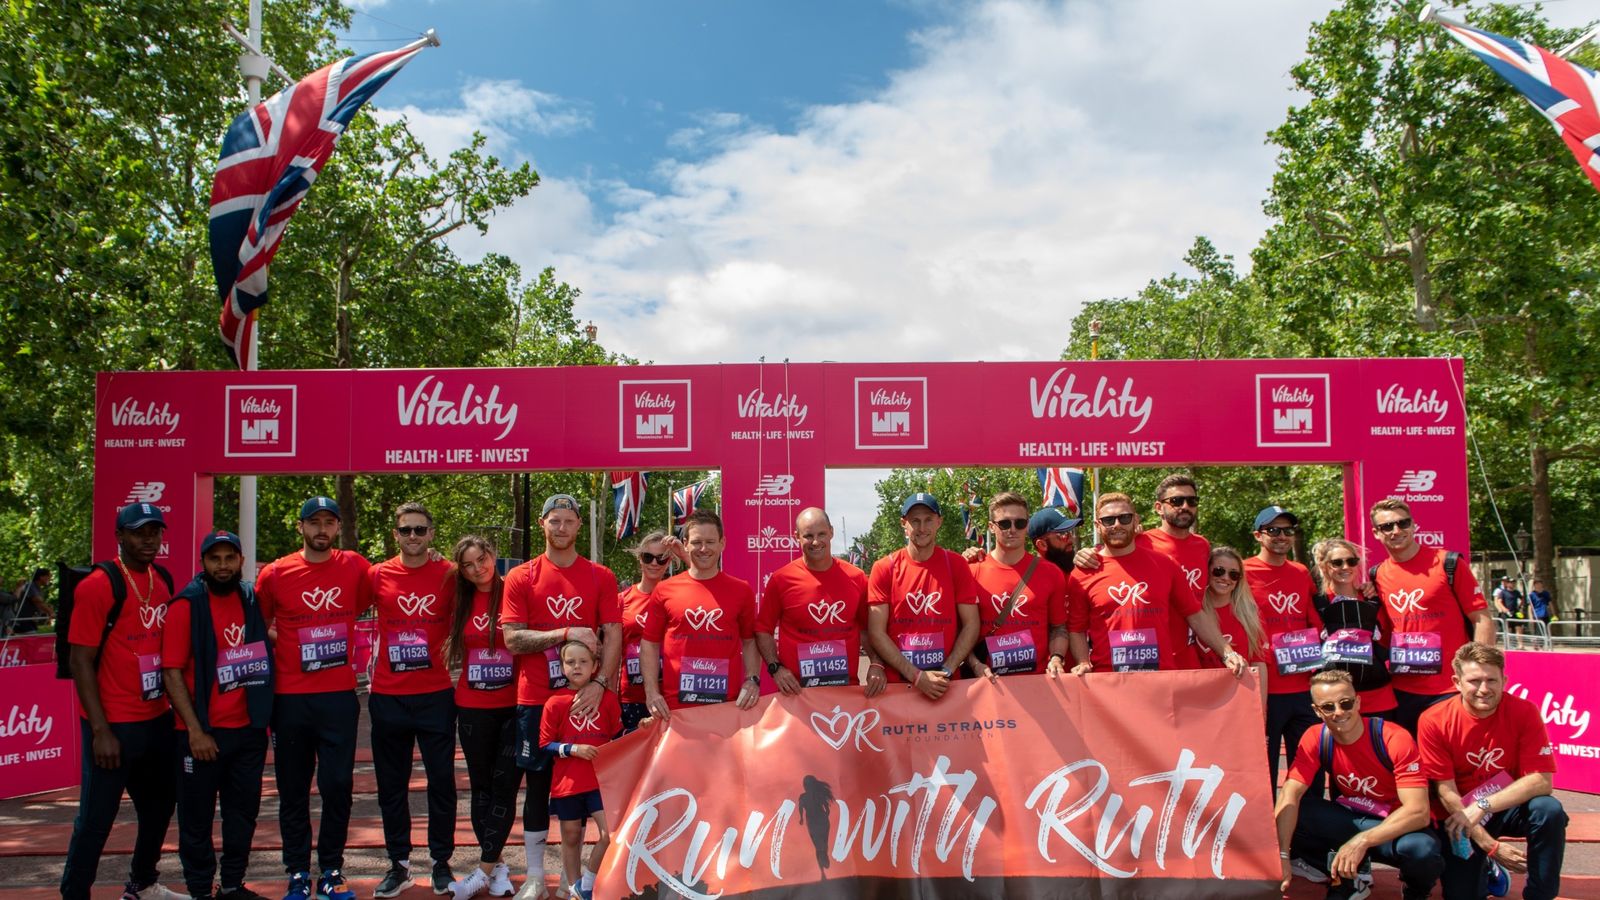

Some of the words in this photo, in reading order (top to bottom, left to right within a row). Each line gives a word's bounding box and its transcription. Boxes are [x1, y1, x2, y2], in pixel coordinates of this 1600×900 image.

[635, 391, 675, 412] Vitality
[871, 388, 911, 410] Vitality
[1030, 368, 1152, 433] Vitality
[1272, 385, 1314, 407] Vitality
[1377, 384, 1448, 422] Vitality
[241, 396, 281, 418] Vitality
[398, 375, 518, 441] Vitality
[738, 389, 807, 426] Vitality
[112, 397, 180, 434] Vitality
[732, 431, 761, 439] HEALTH
[765, 431, 783, 439] LIFE
[787, 430, 814, 439] INVEST
[1371, 427, 1402, 435] HEALTH
[1406, 427, 1423, 435] LIFE
[1427, 426, 1455, 435] INVEST
[105, 439, 135, 447] HEALTH
[139, 439, 154, 447] LIFE
[158, 438, 186, 447] INVEST
[1020, 443, 1072, 456] HEALTH
[1081, 442, 1108, 456] LIFE
[1117, 442, 1165, 455] INVEST
[385, 449, 438, 463] HEALTH
[446, 449, 472, 463] LIFE
[481, 448, 529, 462] INVEST
[765, 497, 801, 506] balance
[1406, 493, 1444, 502] balance
[748, 537, 799, 548] BUXTON
[1414, 533, 1444, 545] TON
[317, 641, 347, 656] 11505
[401, 645, 427, 659] 11526
[1128, 647, 1158, 660] 11585
[1291, 646, 1322, 659] 11525
[1339, 643, 1370, 653] 11427
[914, 652, 943, 664] 11588
[1006, 648, 1035, 663] 11507
[1407, 650, 1440, 662] 11426
[235, 660, 268, 677] 11586
[482, 666, 512, 677] 11535
[816, 659, 847, 672] 11452
[697, 678, 727, 690] 11211
[882, 724, 928, 736] RUTH
[937, 720, 1017, 733] STRAUSS
[906, 732, 994, 744] FOUNDATION
[26, 747, 62, 762] INVEST
[1559, 743, 1600, 758] INVEST
[616, 788, 796, 900] Run
[832, 754, 998, 883] with
[1025, 748, 1247, 880] Ruth
